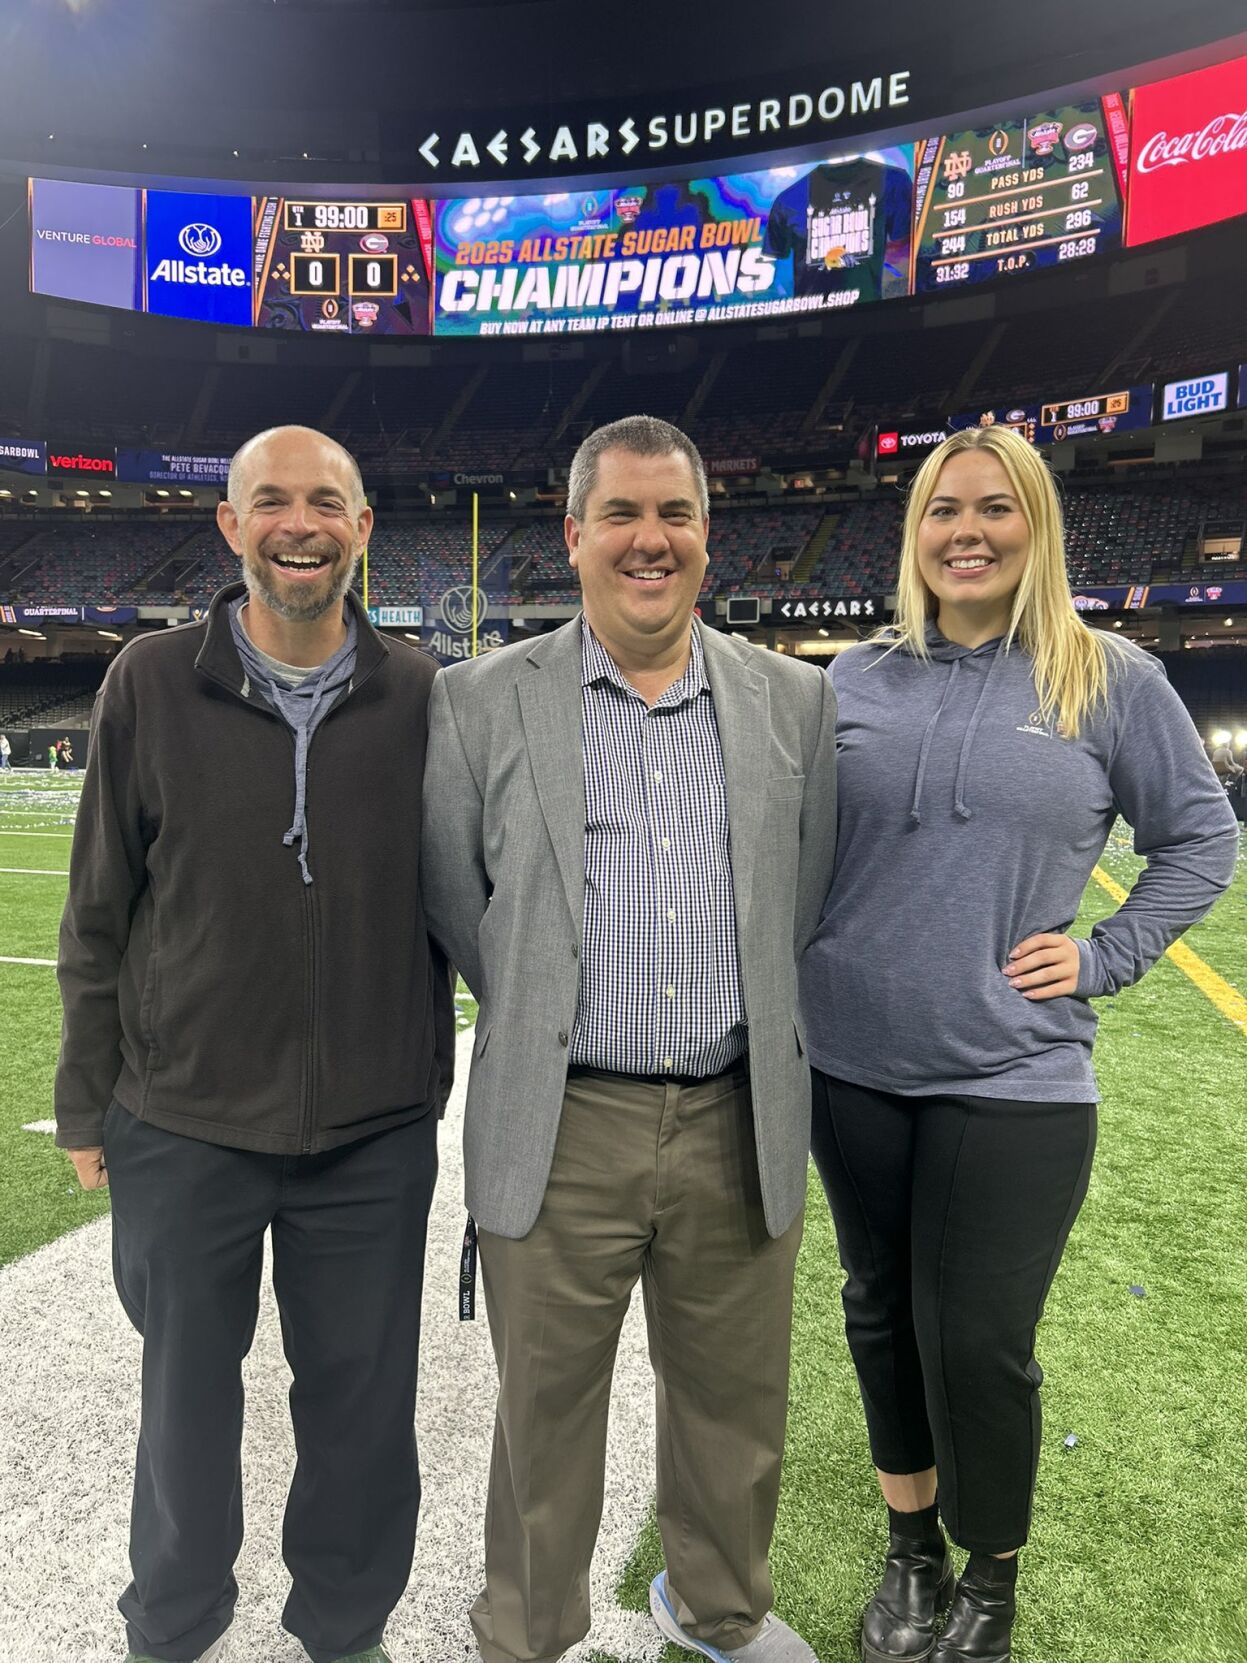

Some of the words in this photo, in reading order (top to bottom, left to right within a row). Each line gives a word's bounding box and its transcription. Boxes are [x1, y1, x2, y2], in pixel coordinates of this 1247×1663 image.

[418, 116, 640, 168] CAESARS
[648, 71, 911, 148] SUPERDOME
[1069, 152, 1094, 172] 234
[991, 174, 1019, 190] PASS
[1023, 168, 1044, 184] YDS
[947, 182, 964, 199] 90
[1072, 182, 1089, 200] 62
[315, 205, 368, 229] 99:00
[989, 203, 1018, 219] RUSH
[1022, 196, 1043, 212] YDS
[943, 209, 966, 228] 154
[1066, 210, 1092, 230] 296
[36, 229, 91, 244] VENTURE
[92, 235, 137, 249] GLOBAL
[455, 240, 514, 265] 2025
[517, 232, 618, 263] ALLSTATE
[621, 225, 696, 256] SUGAR
[700, 217, 763, 248] BOWL
[986, 230, 1019, 246] TOTAL
[1023, 224, 1044, 240] YDS
[941, 237, 966, 255] 244
[1059, 238, 1096, 260] 28:28
[309, 261, 323, 286] 0
[936, 263, 970, 283] 31:32
[997, 255, 1030, 273] T.O.P.
[366, 262, 381, 287] 0
[439, 247, 778, 312] CHAMPIONS
[480, 321, 502, 335] BUY
[503, 321, 529, 334] NOW
[529, 320, 543, 333] AT
[543, 319, 567, 332] ANY
[567, 317, 597, 331] TEAM
[610, 314, 638, 328] TENT
[638, 312, 654, 327] OR
[655, 309, 694, 326] ONLINE
[694, 308, 707, 323] @
[707, 288, 860, 321] ALLSTATESUGARBOWL.SHOP
[1176, 380, 1215, 400] BUD
[1067, 400, 1099, 418] 99:00
[1167, 392, 1222, 415] LIGHT
[901, 431, 946, 446] TOYOTA
[50, 454, 113, 471] verizon
[170, 463, 190, 472] PETE
[711, 459, 757, 472] MARKETS
[454, 473, 503, 484] Chevron
[24, 607, 78, 616] QUARTERFINAL
[382, 610, 420, 622] HEALTH
[781, 600, 875, 617] CAESARS
[463, 1290, 471, 1314] BOWL
